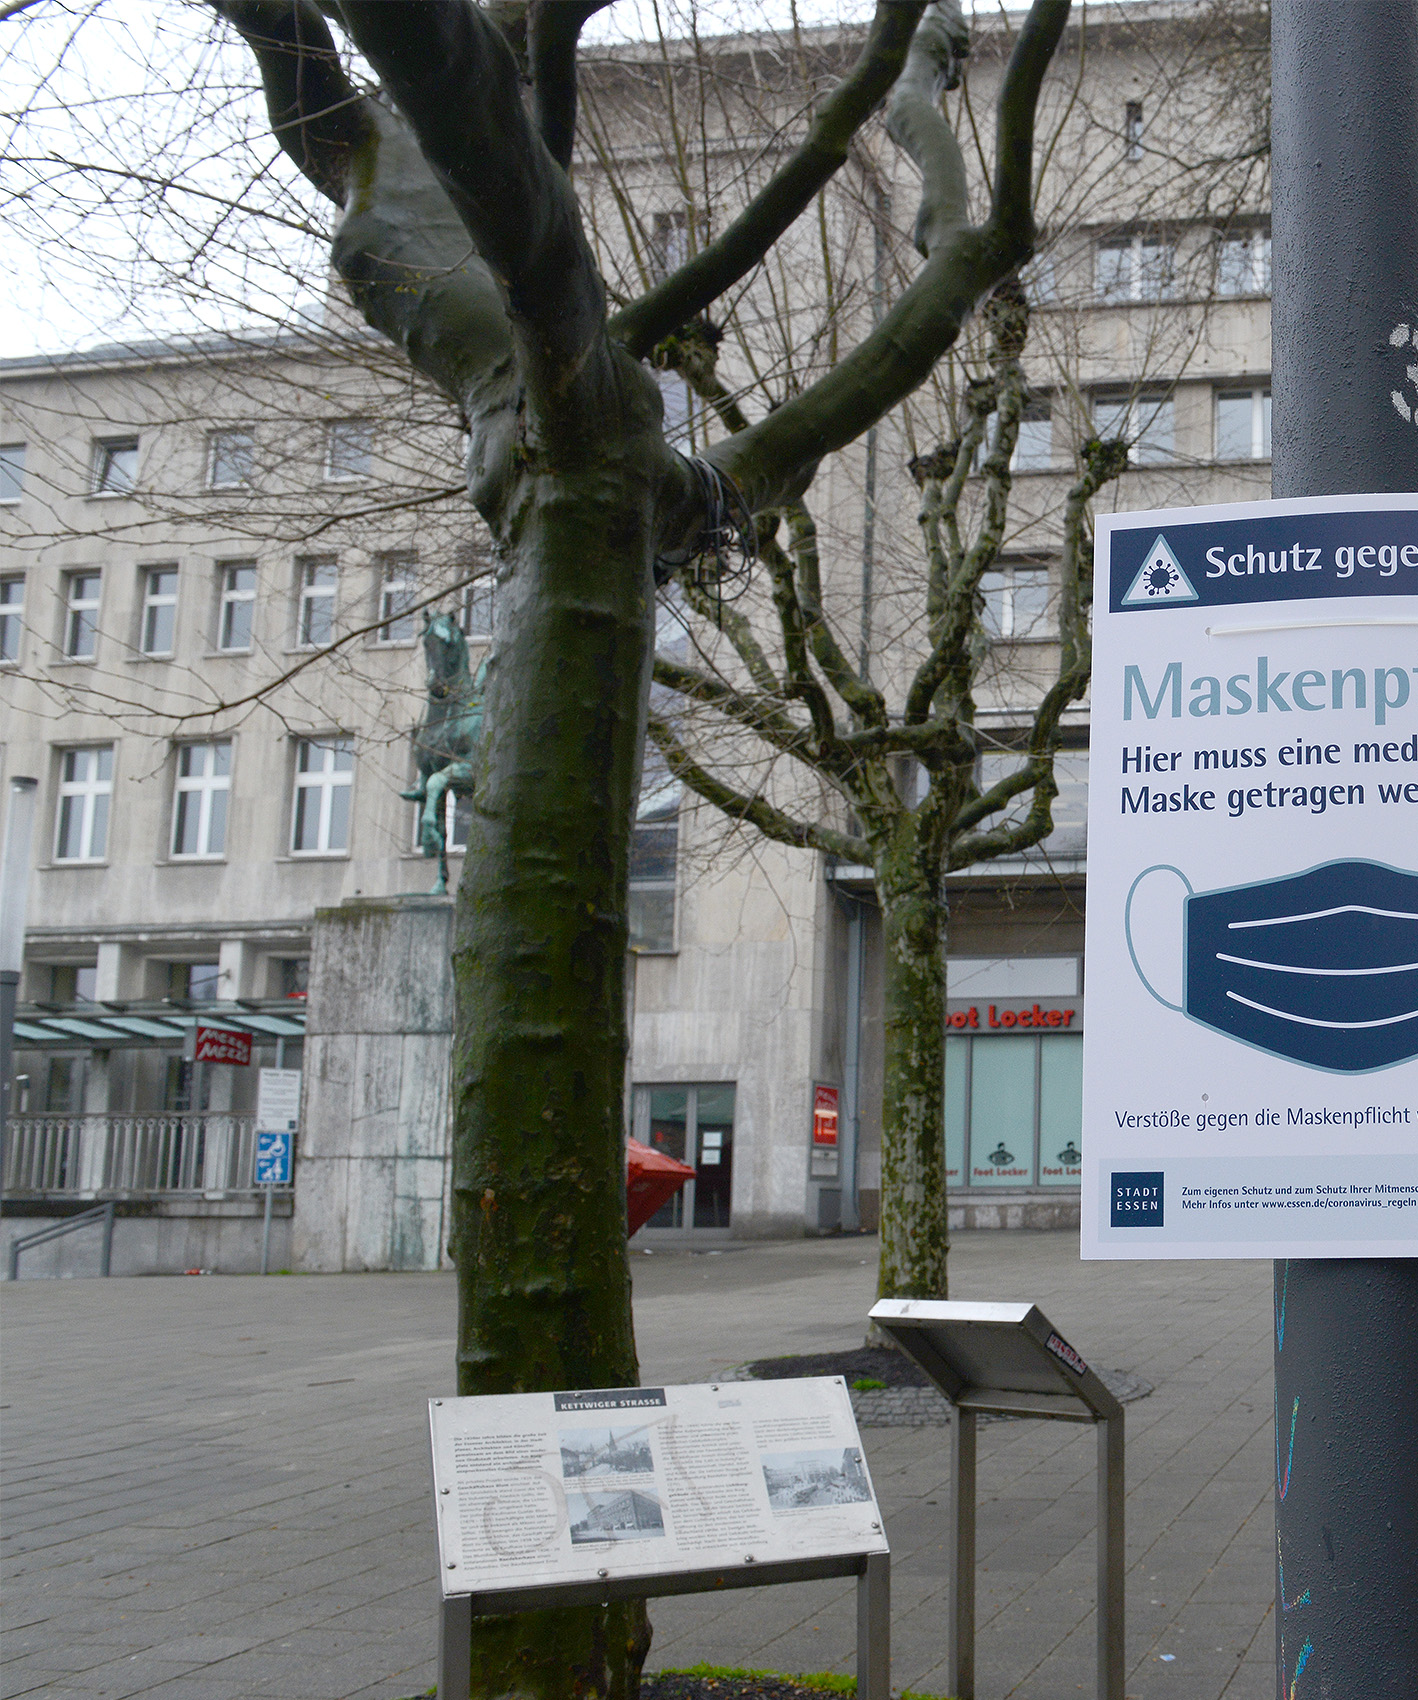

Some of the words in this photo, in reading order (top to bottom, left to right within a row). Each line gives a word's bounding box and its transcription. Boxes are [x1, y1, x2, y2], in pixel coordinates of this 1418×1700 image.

[1205, 541, 1322, 579] Schutz
[1121, 747, 1183, 774] Hier
[1193, 746, 1268, 770] muss
[1278, 738, 1341, 766] eine
[1120, 785, 1217, 814] Maske
[1227, 782, 1366, 817] getragen
[987, 1003, 1075, 1028] Locker
[1115, 1109, 1190, 1128] Verstöße
[1196, 1111, 1249, 1131] gegen
[1254, 1107, 1281, 1127] die
[1286, 1105, 1411, 1130] Maskenpflicht
[973, 1167, 994, 1176] Foot
[996, 1166, 1029, 1176] Locker
[1116, 1187, 1158, 1198] STADT
[1181, 1185, 1201, 1196] Zum
[1203, 1185, 1238, 1198] eigenen
[1241, 1184, 1272, 1195] Schutz
[1274, 1184, 1293, 1195] und
[1294, 1186, 1313, 1195] zum
[1316, 1183, 1347, 1194] Schutz
[1349, 1182, 1373, 1194] Ihrer
[1116, 1201, 1158, 1211] ESSEN
[1181, 1199, 1206, 1210] Mehr
[1208, 1199, 1232, 1210] Infos
[1234, 1199, 1259, 1210] unter
[1261, 1196, 1417, 1210] www.essen.de/coronavirus_regeln
[560, 1402, 617, 1411] KETTWIGER
[619, 1398, 662, 1407] STRASSE
